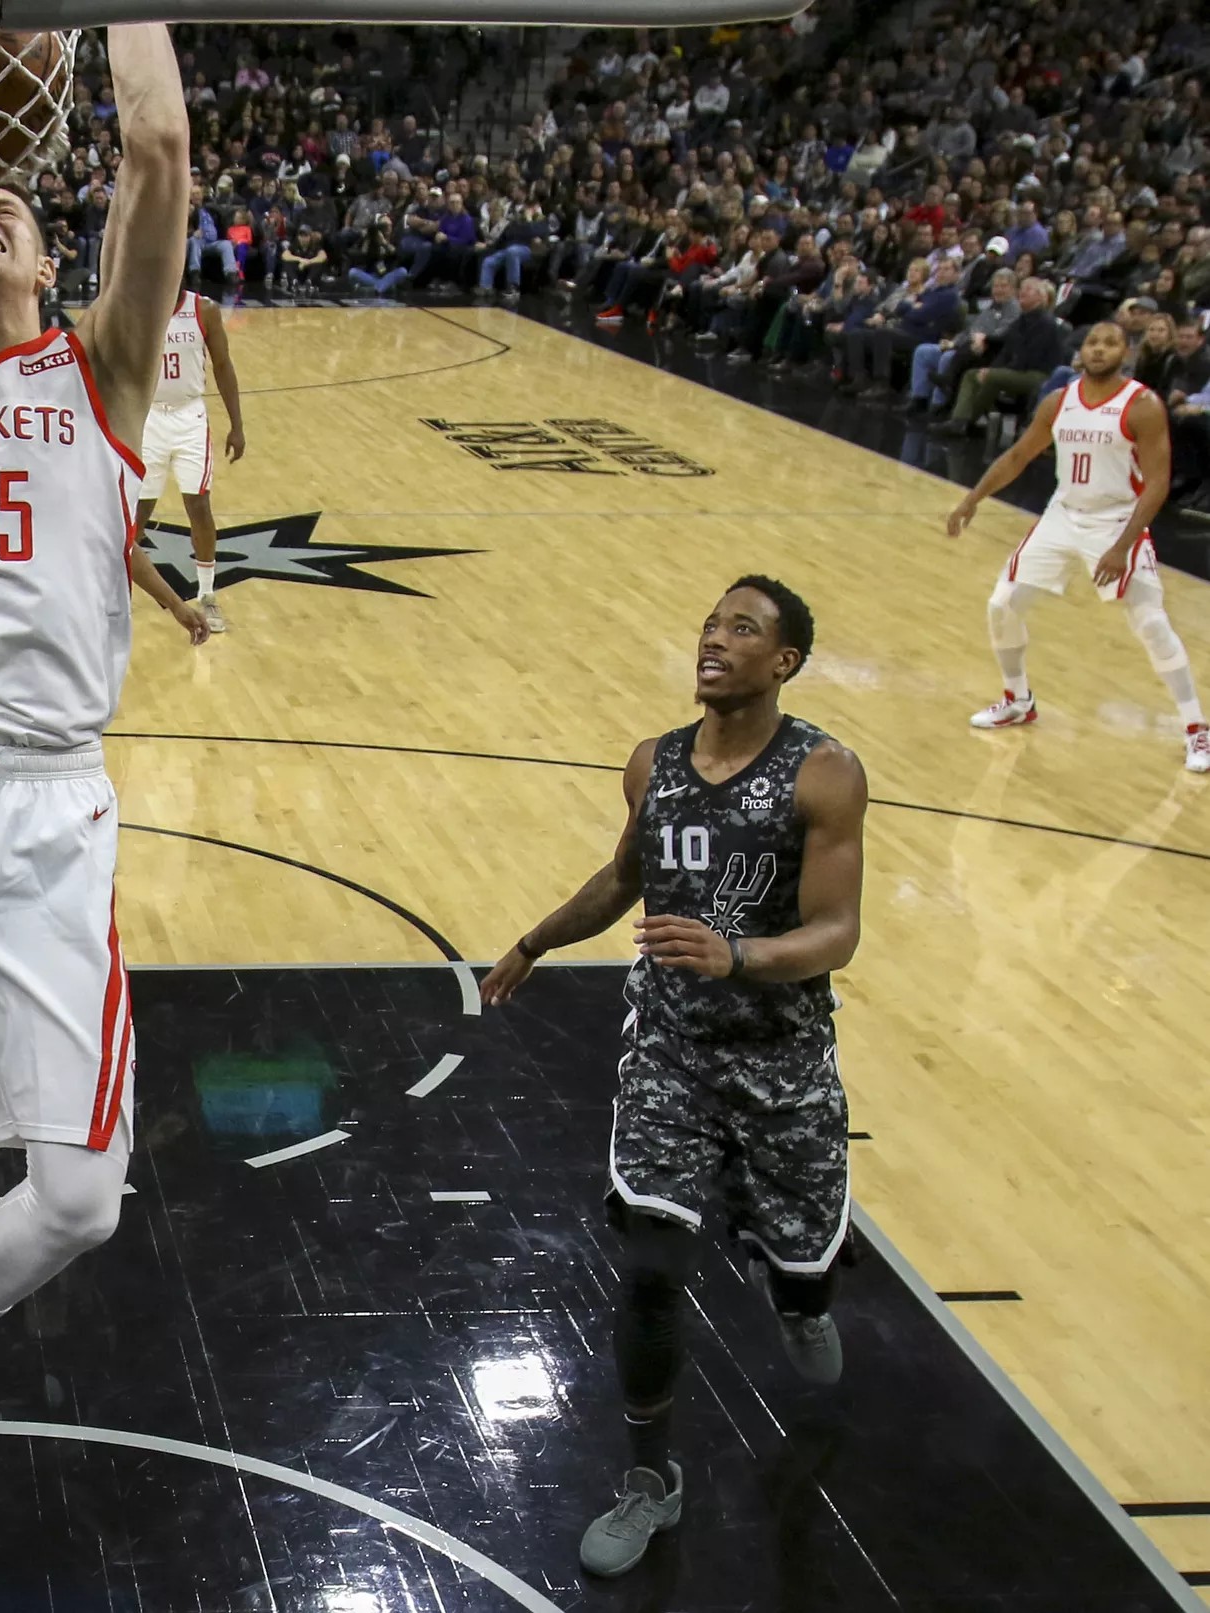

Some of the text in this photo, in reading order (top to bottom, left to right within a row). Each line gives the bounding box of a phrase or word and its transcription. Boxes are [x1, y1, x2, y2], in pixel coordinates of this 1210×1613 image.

[167, 331, 195, 343] KETS
[163, 353, 180, 380] 13
[1058, 428, 1113, 444] ROCKETS
[1071, 453, 1092, 484] 10
[740, 796, 774, 810] Frost
[659, 824, 710, 871] 10
